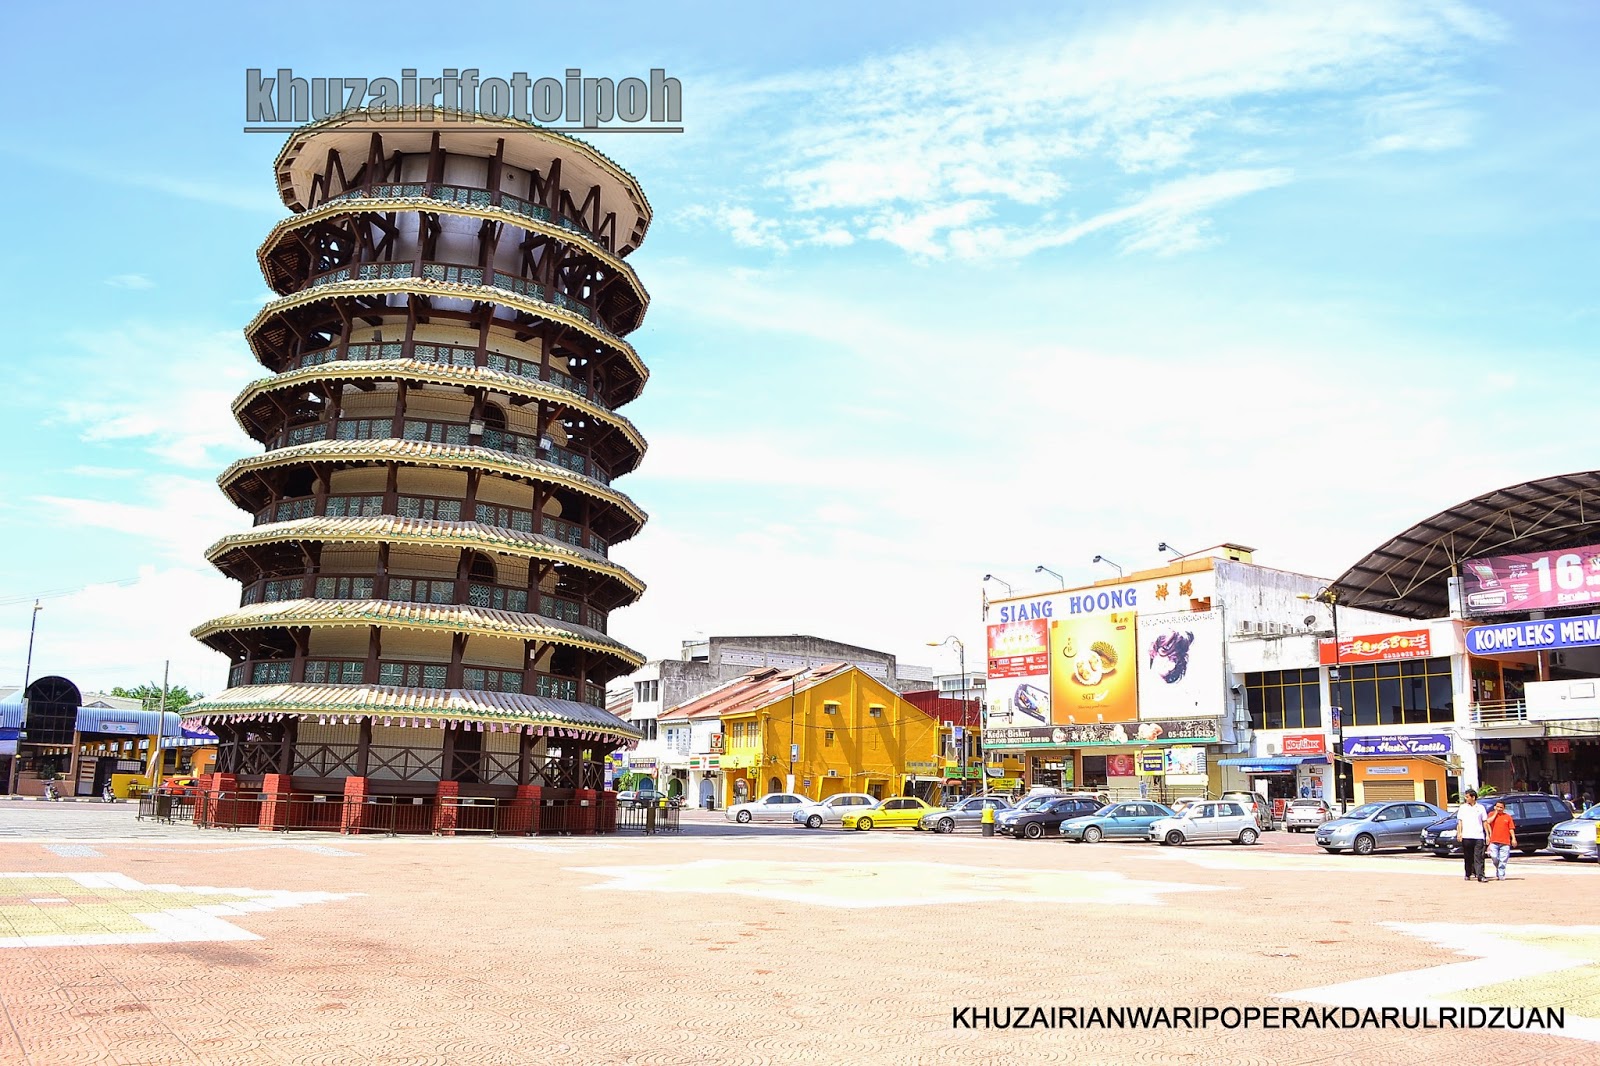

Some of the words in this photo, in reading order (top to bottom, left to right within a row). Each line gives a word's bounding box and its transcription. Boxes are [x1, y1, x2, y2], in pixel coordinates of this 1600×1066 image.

[1000, 601, 1053, 623] SIANG
[1070, 588, 1137, 614] HOONG
[1475, 624, 1555, 650] KOMPLEKS
